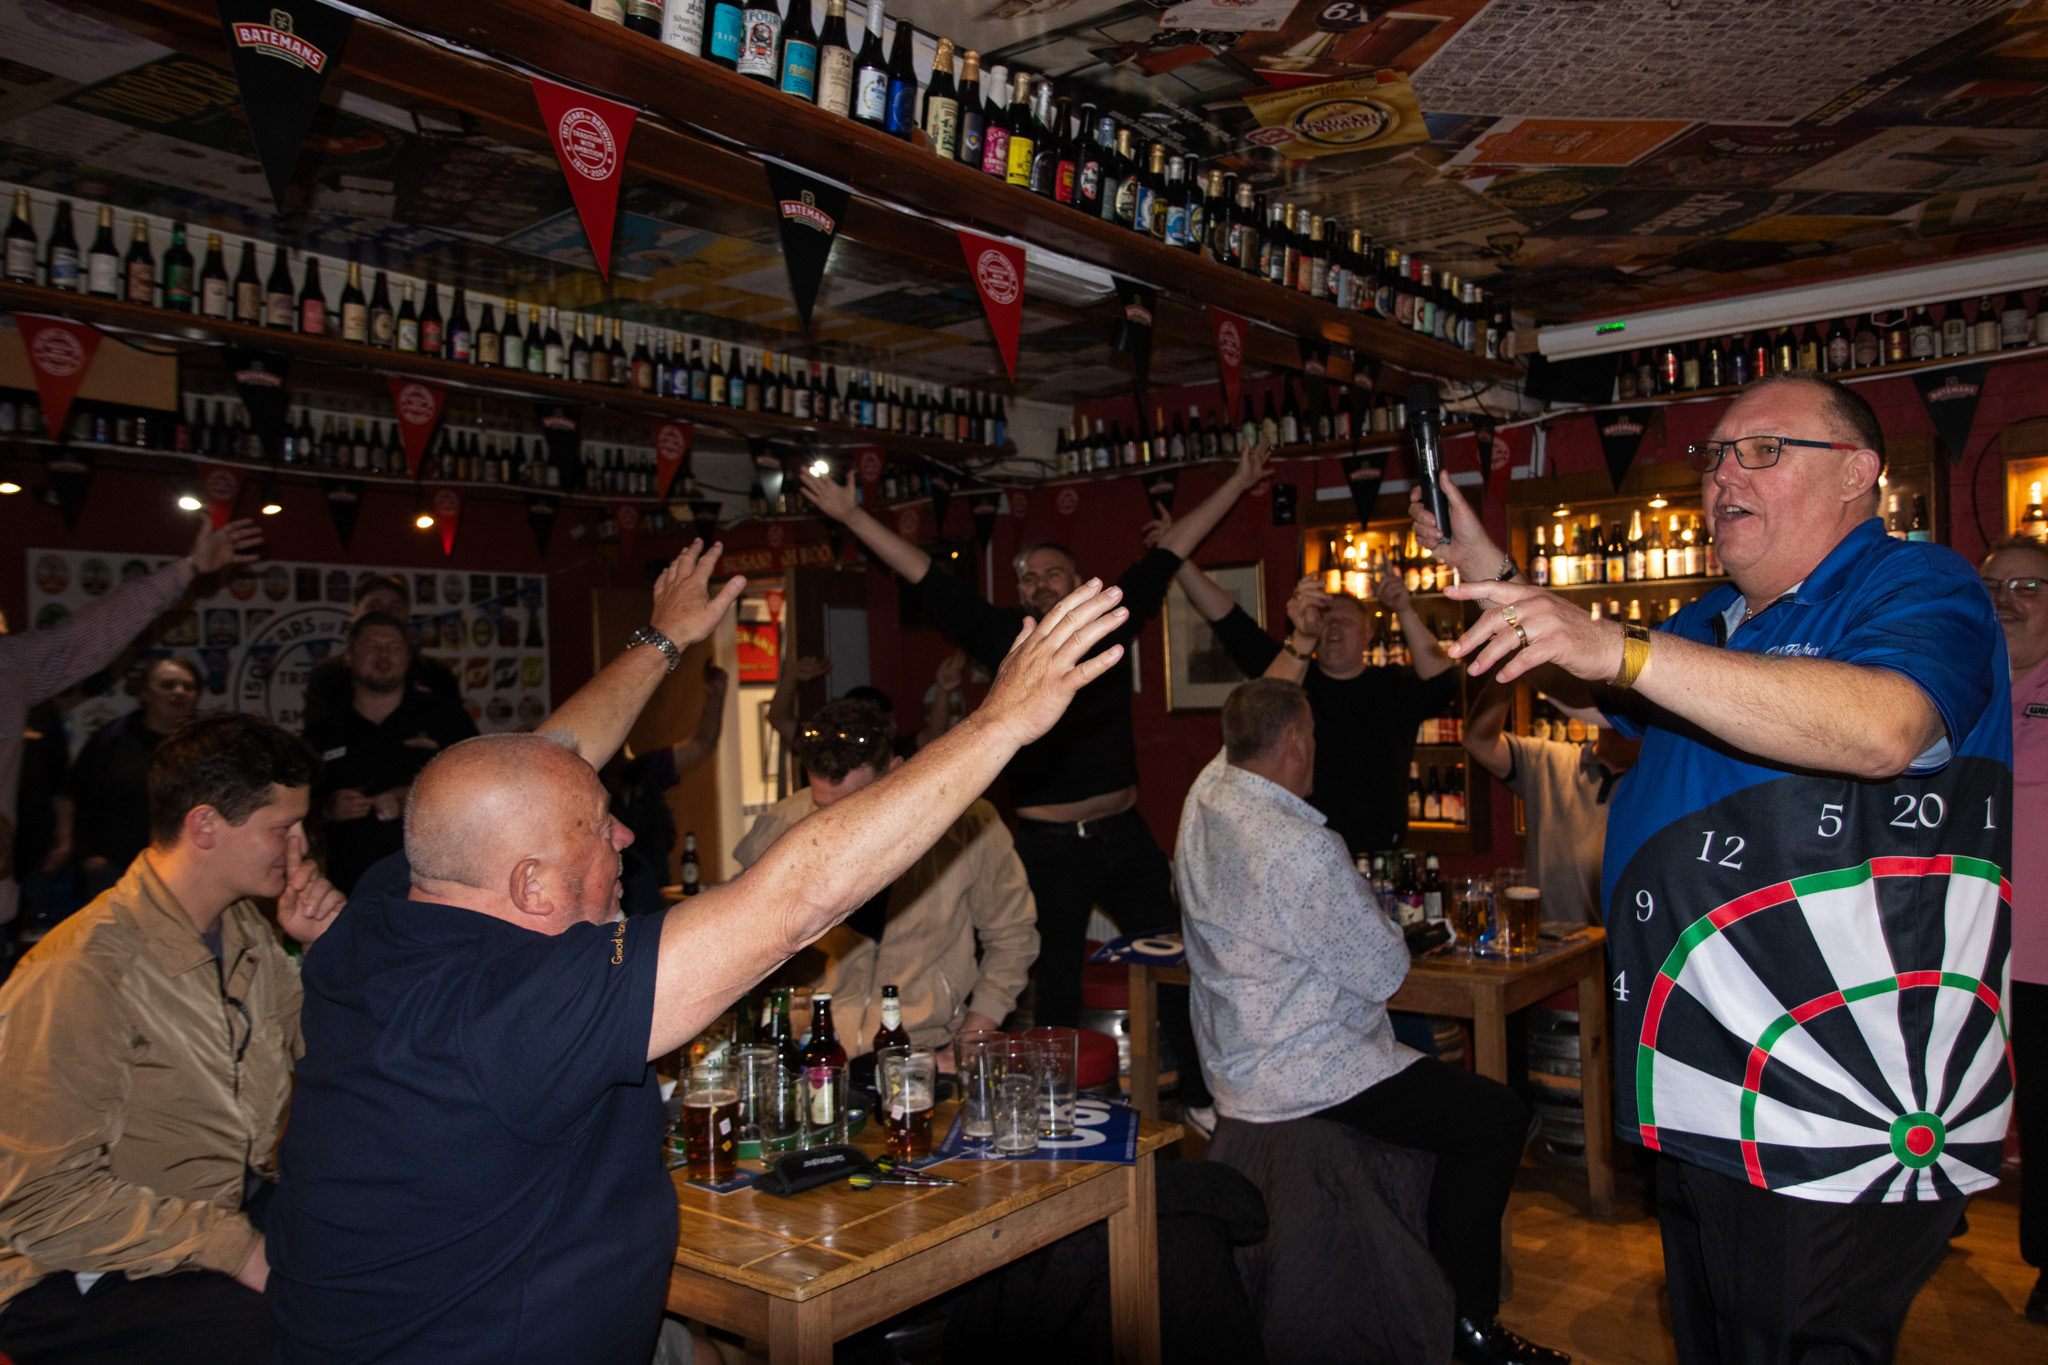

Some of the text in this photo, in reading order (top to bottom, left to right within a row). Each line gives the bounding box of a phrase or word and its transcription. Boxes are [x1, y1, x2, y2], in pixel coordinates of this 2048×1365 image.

[239, 27, 321, 66] BATEMANS
[565, 111, 584, 125] YEARS
[592, 116, 613, 152] BREWING
[572, 129, 603, 144] TRADITION
[580, 139, 596, 149] WITH
[573, 157, 608, 177] 1874-2024
[574, 144, 603, 159] AMBITION
[784, 203, 831, 230] BATEMANS
[1817, 803, 1844, 837] 5
[1889, 792, 1947, 829] 20
[1983, 795, 1997, 830] 1
[1696, 830, 1746, 871] 12
[1635, 889, 1654, 922] 9
[610, 938, 624, 965] Good
[1613, 970, 1630, 1001] 4
